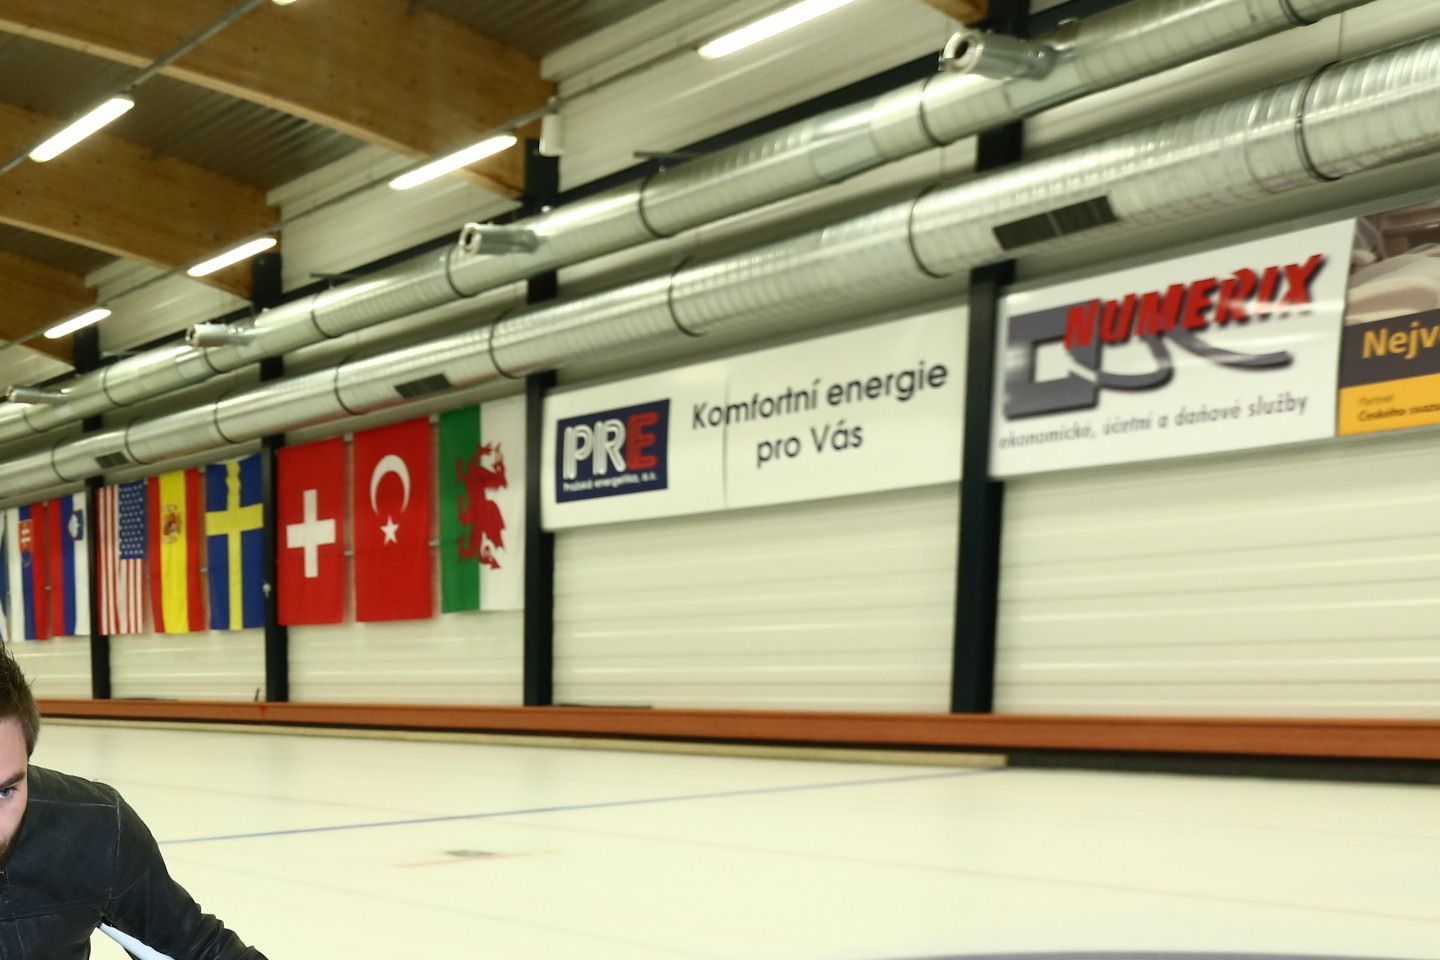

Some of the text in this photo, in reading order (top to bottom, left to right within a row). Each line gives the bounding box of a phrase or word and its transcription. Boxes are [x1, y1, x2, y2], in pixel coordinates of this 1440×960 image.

[1063, 253, 1324, 350] NUMERIX
[691, 360, 949, 430] Komfortní energie
[1157, 414, 1170, 429] a
[1248, 391, 1309, 417] služby
[563, 411, 659, 480] PRE
[756, 419, 864, 469] pro Vás
